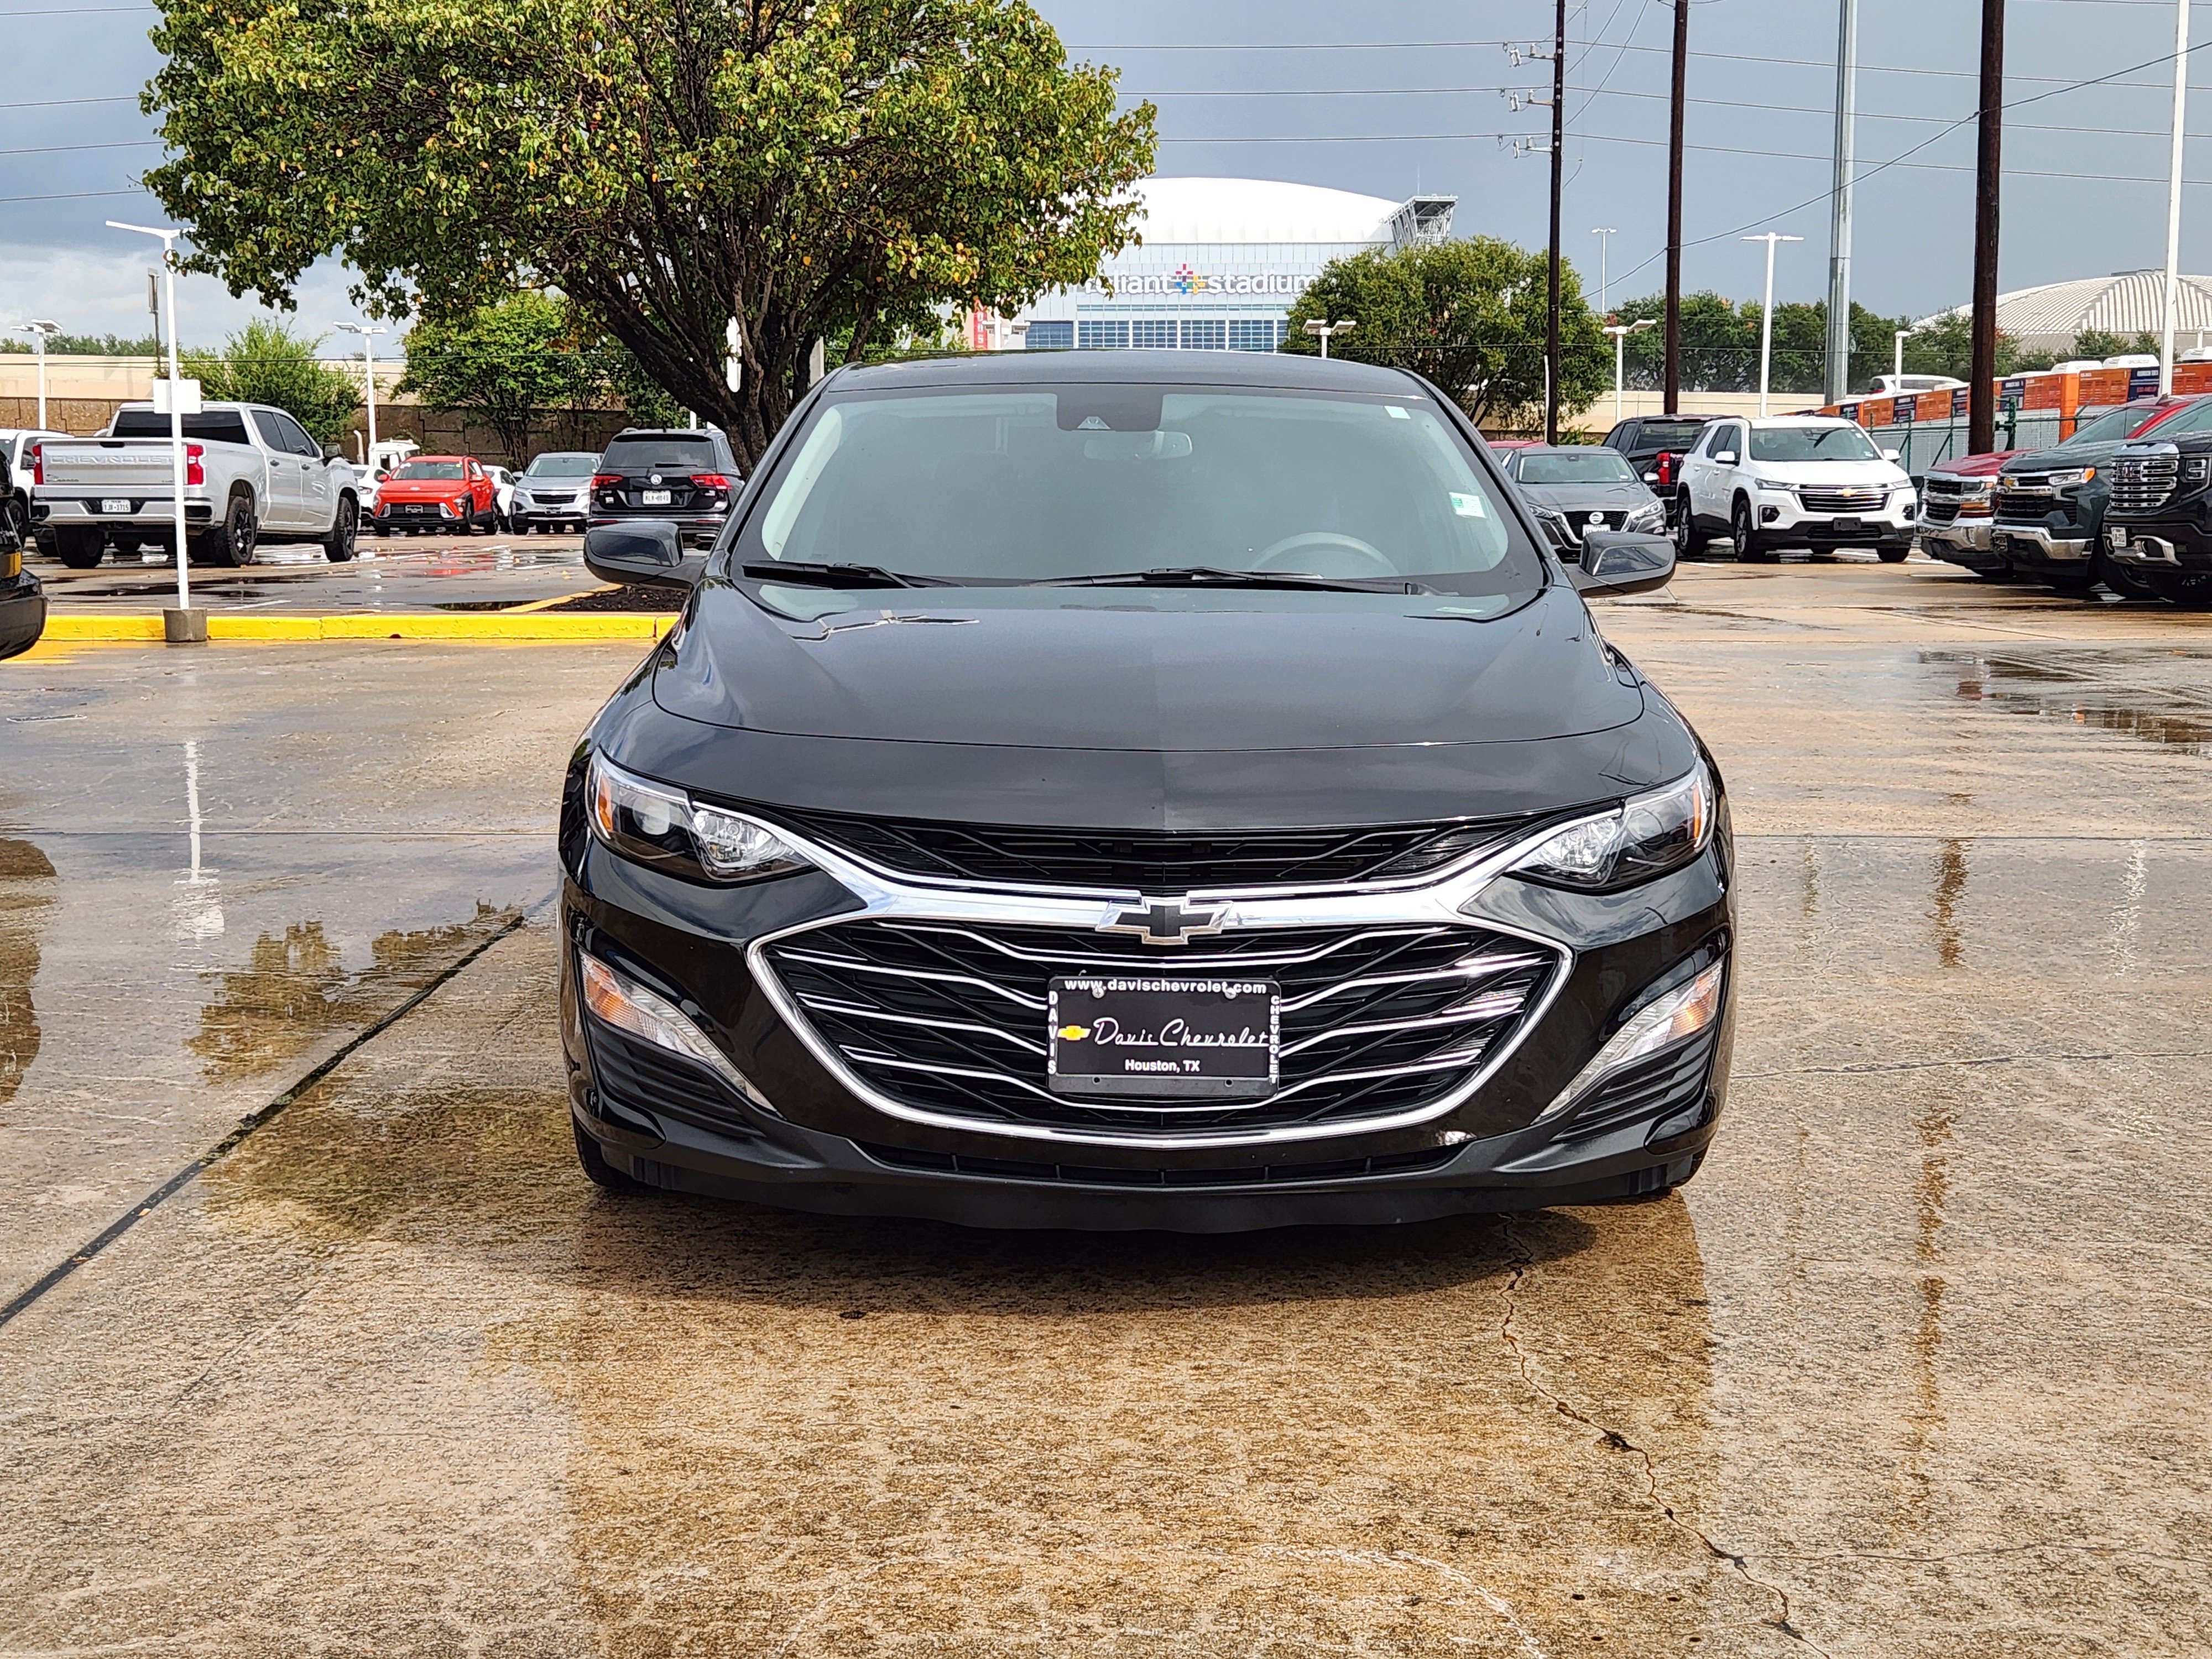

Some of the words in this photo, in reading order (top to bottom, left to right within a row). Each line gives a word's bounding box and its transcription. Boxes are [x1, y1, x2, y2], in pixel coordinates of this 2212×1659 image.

[1208, 269, 1319, 294] stadium
[50, 455, 174, 465] CHEVROLET
[1065, 979, 1267, 994] www.davischevroletcom
[1048, 991, 1058, 1074] DAVIS
[1093, 1016, 1159, 1046] Davis
[1160, 1018, 1269, 1047] Chevrolet
[1269, 995, 1279, 1083] CHEVROLET
[1125, 1059, 1180, 1073] Houston,
[1183, 1060, 1201, 1072] TX
